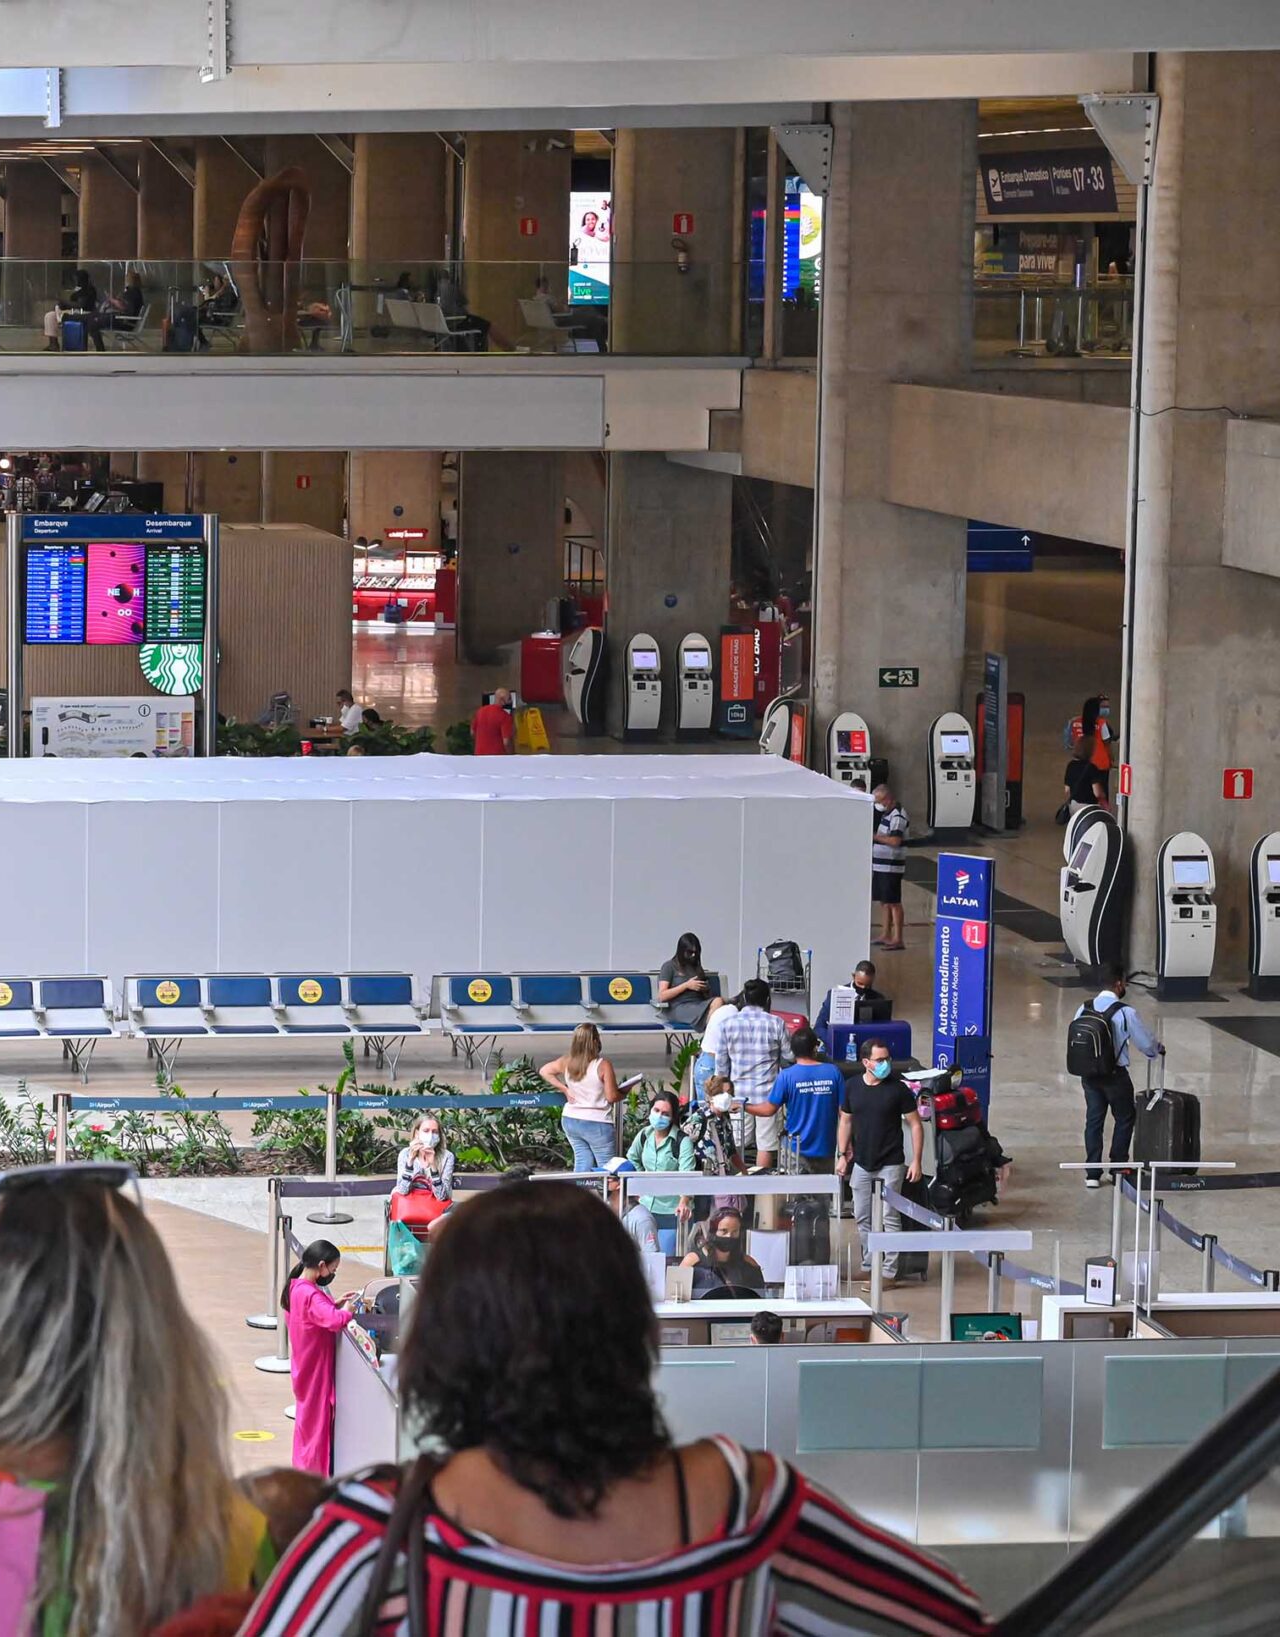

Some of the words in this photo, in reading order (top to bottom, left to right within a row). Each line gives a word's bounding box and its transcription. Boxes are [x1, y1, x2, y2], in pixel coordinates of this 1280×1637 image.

[1072, 166, 1085, 191] 07
[1090, 165, 1105, 191] 33
[1019, 254, 1035, 270] para
[34, 519, 69, 527] Embarque
[145, 519, 192, 527] Desembarque
[943, 895, 979, 907] LATAM
[970, 925, 981, 944] 1
[951, 956, 960, 989] Modules
[938, 926, 950, 1036] Autoatendimento
[950, 1021, 958, 1037] Self
[242, 1101, 270, 1109] BHAirport
